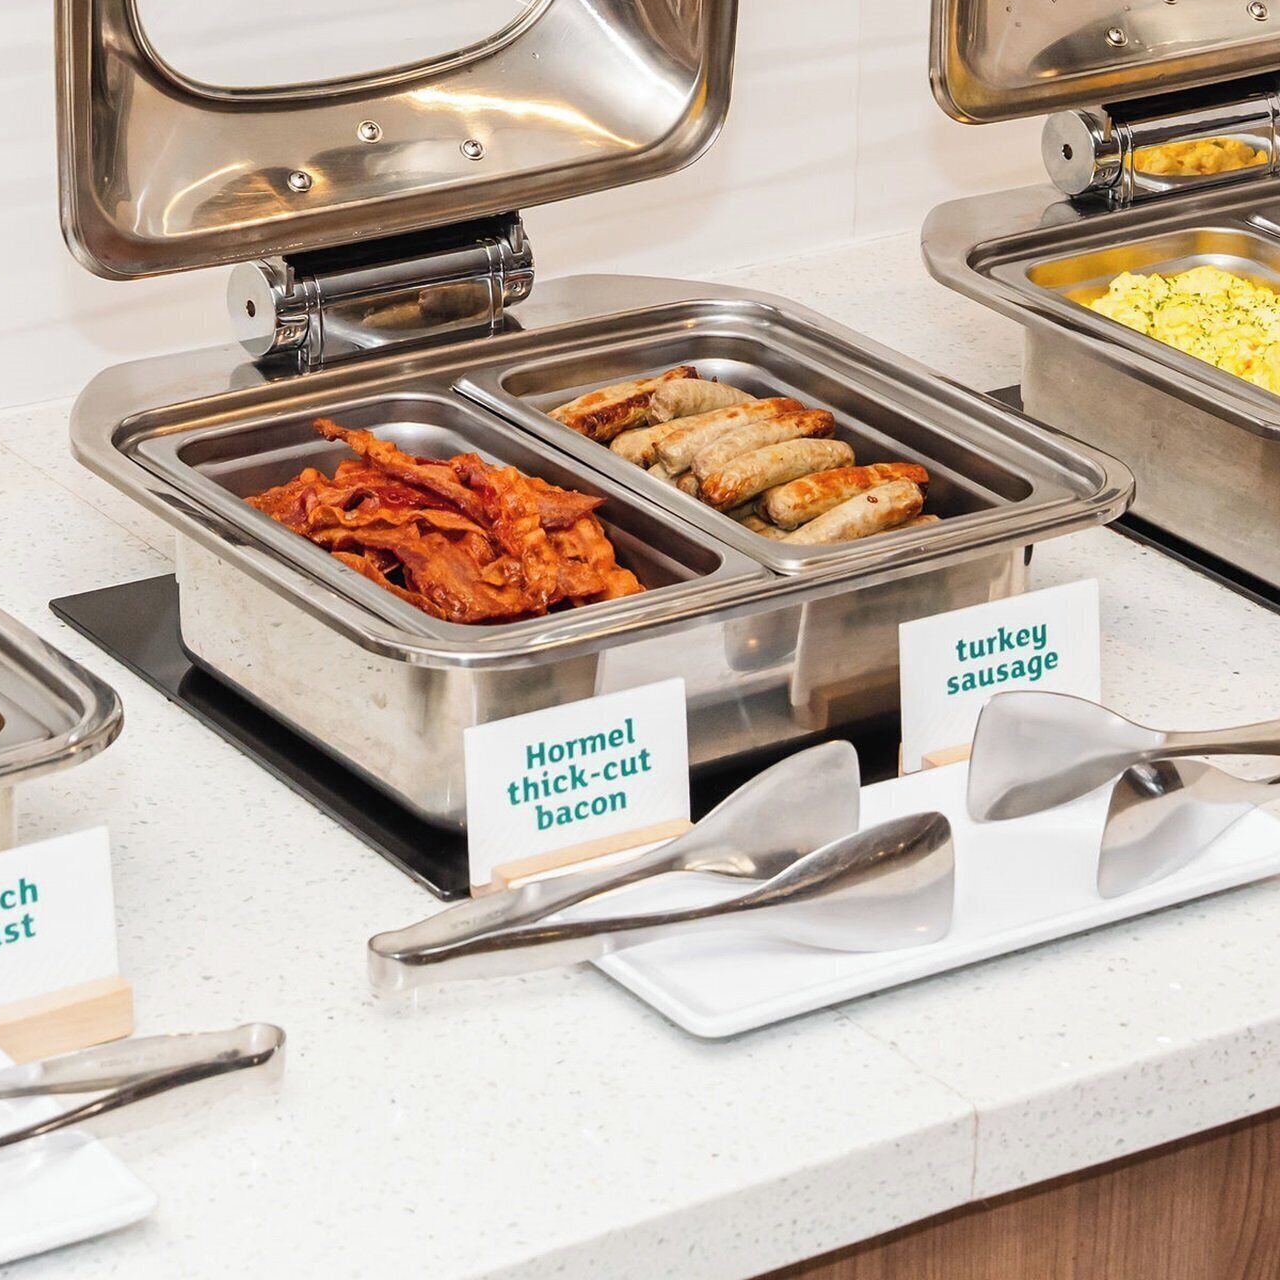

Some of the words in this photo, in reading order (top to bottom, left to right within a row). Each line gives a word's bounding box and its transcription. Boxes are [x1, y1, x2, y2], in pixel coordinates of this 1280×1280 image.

[955, 623, 1048, 662] turkey
[946, 651, 1059, 695] sausage
[525, 718, 636, 769] Hormel
[506, 749, 652, 806] thick-cut
[535, 792, 628, 831] bacon
